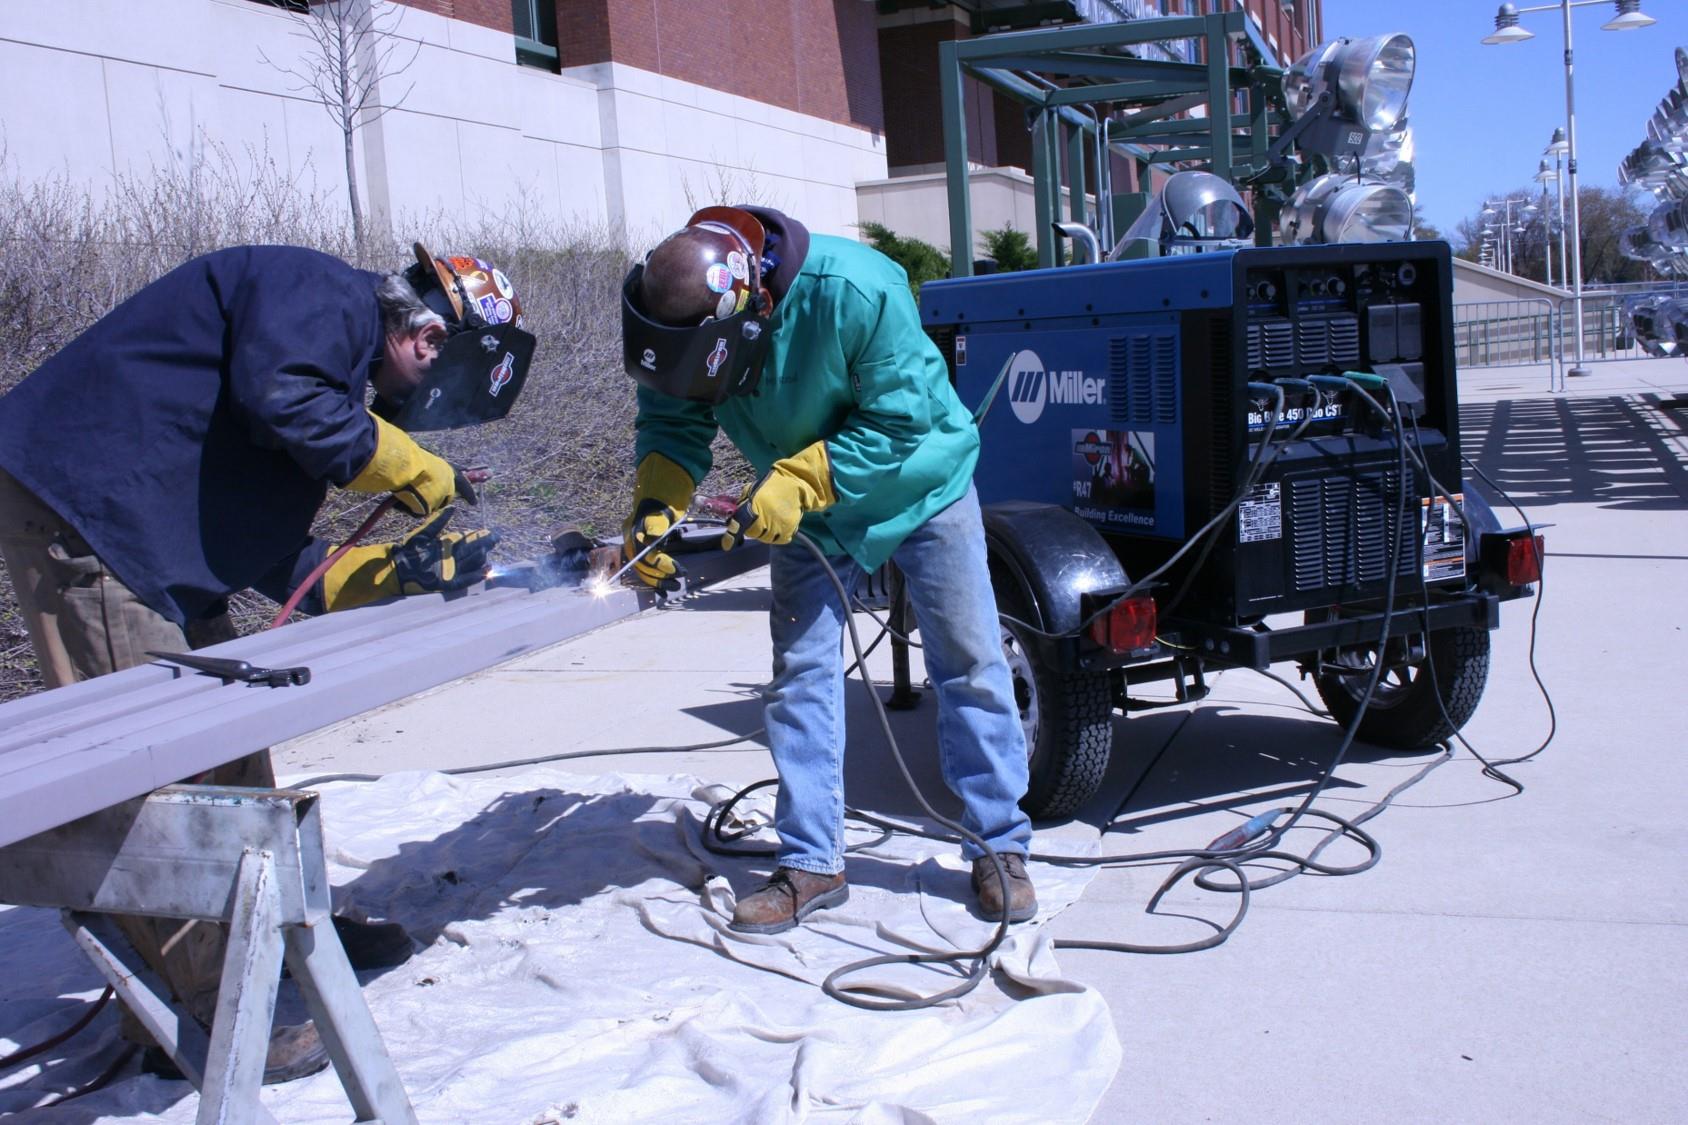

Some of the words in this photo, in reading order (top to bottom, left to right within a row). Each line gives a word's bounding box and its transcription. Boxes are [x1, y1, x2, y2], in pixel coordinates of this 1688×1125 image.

[1050, 371, 1105, 404] Miller
[1248, 411, 1262, 424] Big
[1286, 407, 1304, 421] 450
[1325, 403, 1343, 417] CST
[1109, 511, 1154, 526] Excellence
